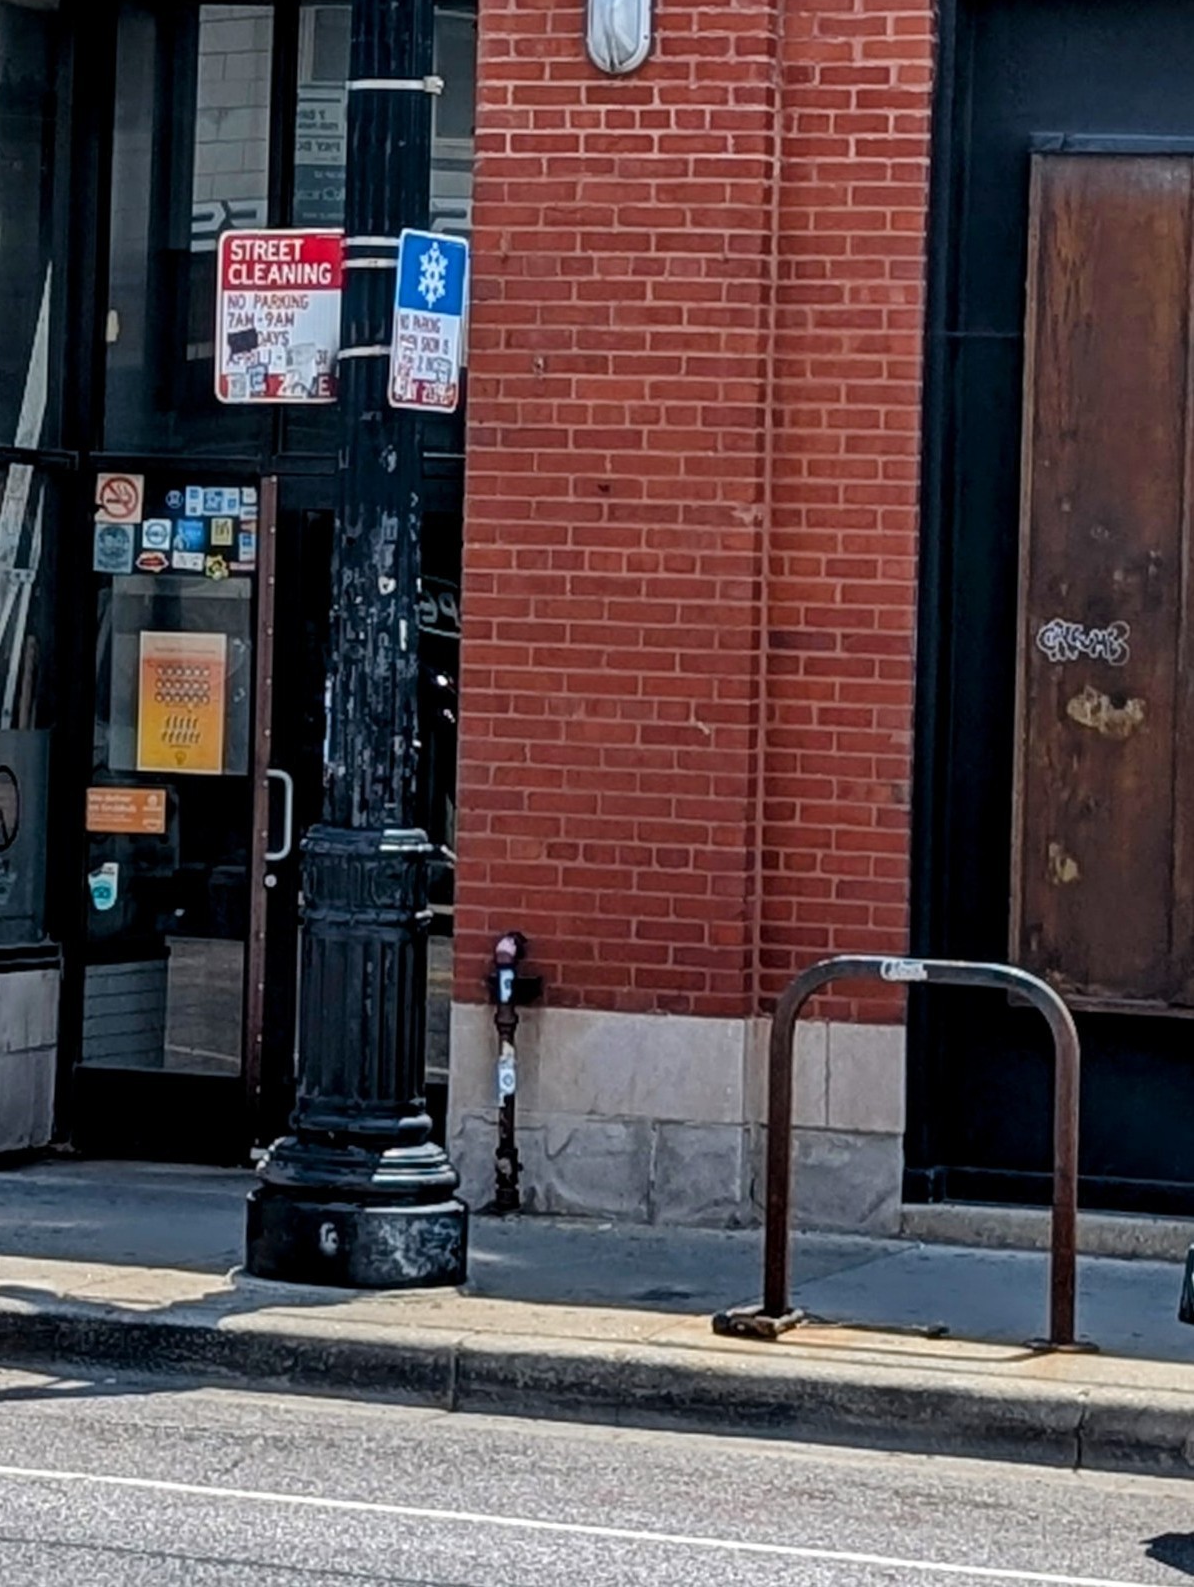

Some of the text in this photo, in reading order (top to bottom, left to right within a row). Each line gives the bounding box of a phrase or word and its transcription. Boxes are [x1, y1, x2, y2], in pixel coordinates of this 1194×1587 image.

[230, 239, 304, 262] STREET
[228, 262, 332, 285] CLEANING
[227, 294, 309, 311] NO PARKING
